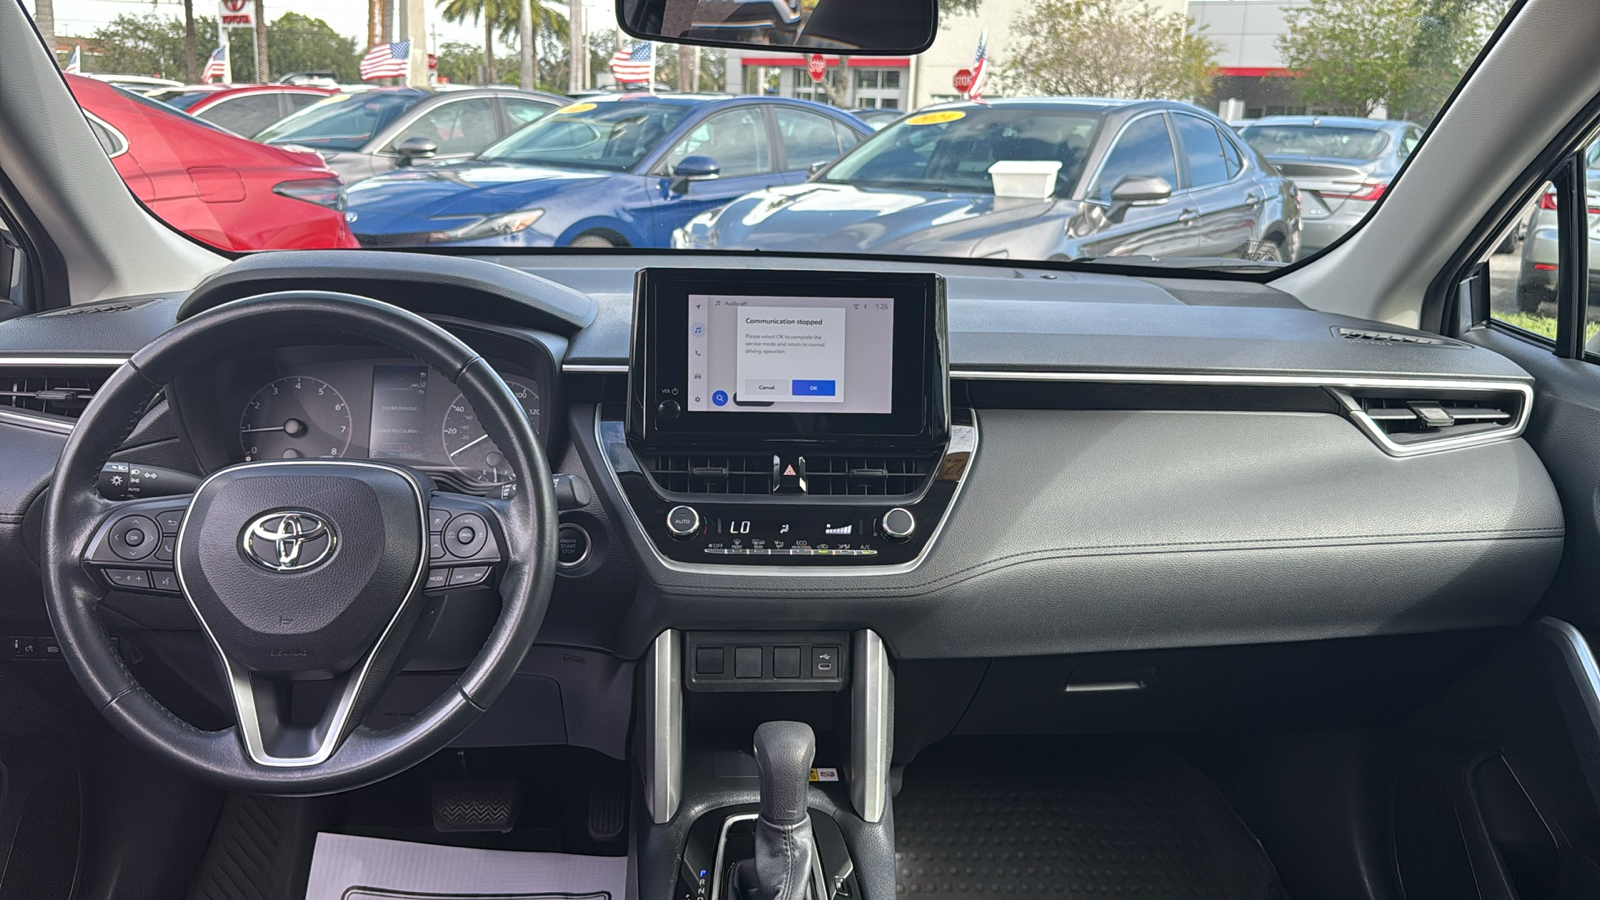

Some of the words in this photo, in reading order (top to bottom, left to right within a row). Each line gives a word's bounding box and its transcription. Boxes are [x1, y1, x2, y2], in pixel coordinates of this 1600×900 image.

[809, 59, 827, 72] STOP
[745, 317, 795, 325] Communication
[796, 318, 823, 326] stopped
[318, 388, 324, 396] 5
[251, 446, 258, 454] 0
[730, 520, 750, 534] LO
